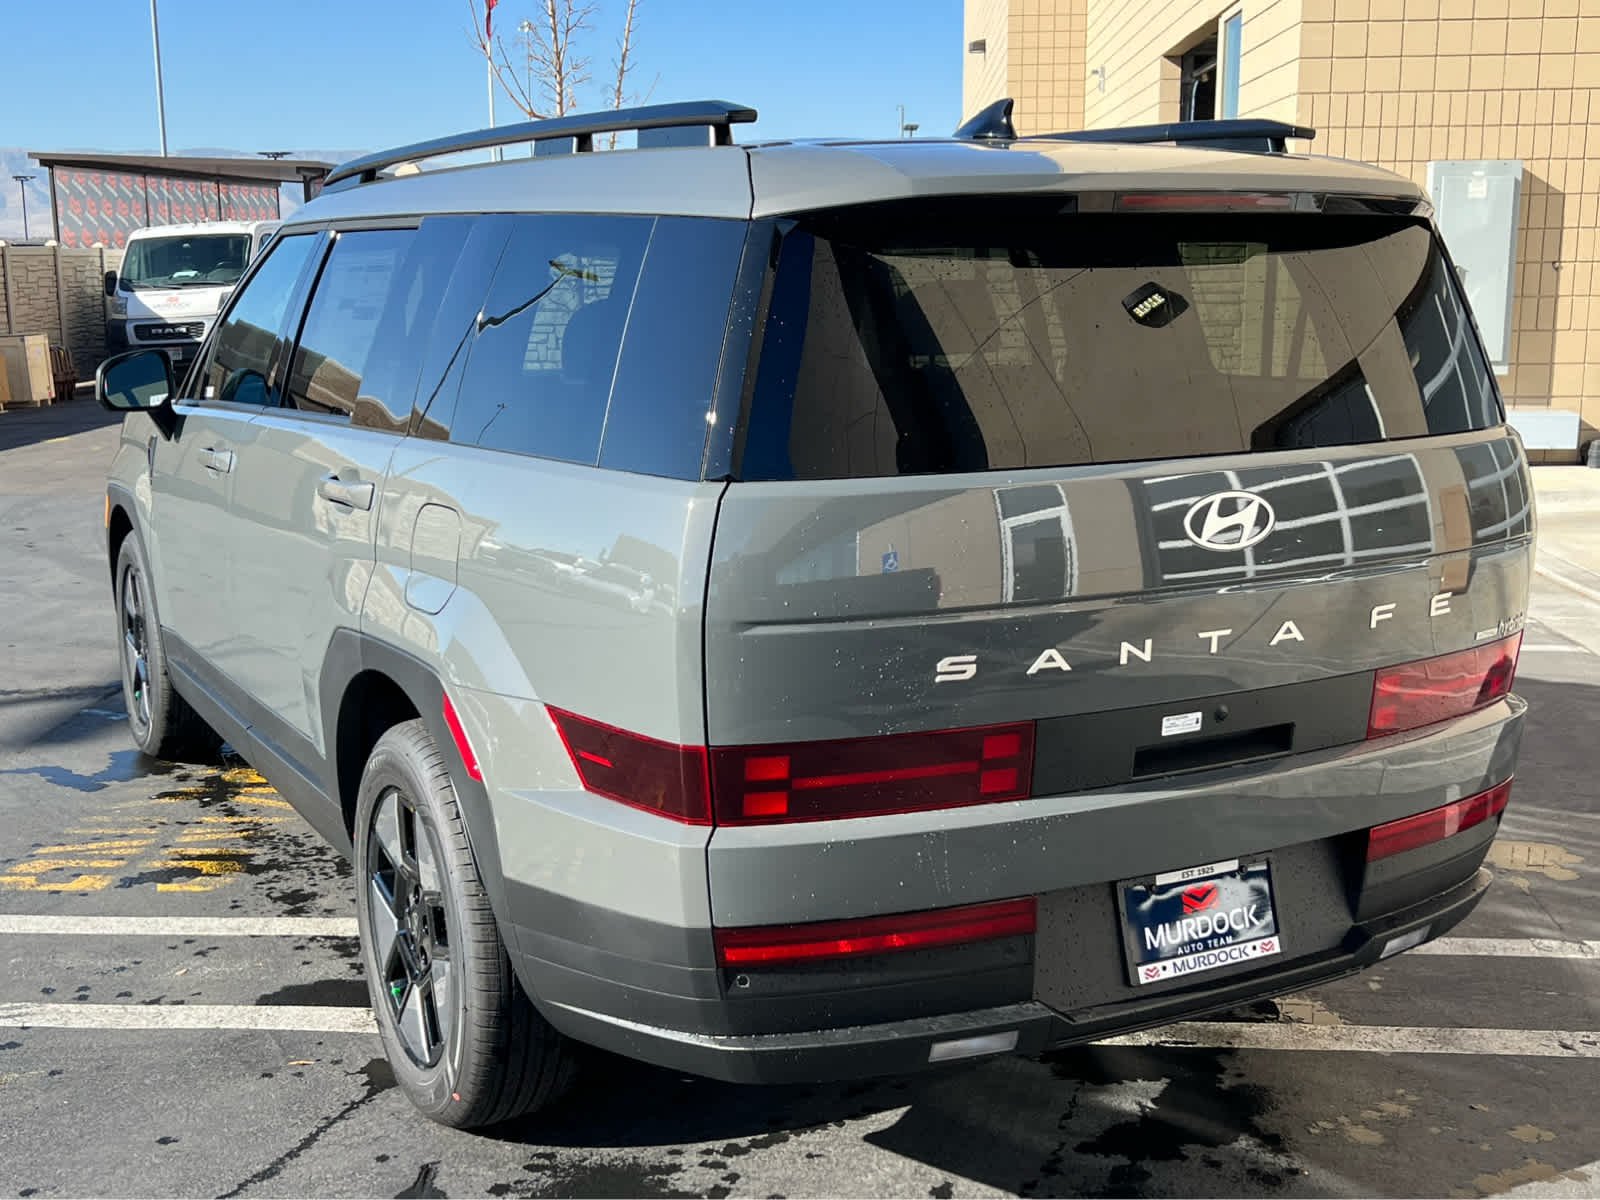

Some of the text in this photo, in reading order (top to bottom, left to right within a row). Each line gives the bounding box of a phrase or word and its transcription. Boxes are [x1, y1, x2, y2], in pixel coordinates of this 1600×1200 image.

[151, 327, 187, 335] RAM
[935, 591, 1453, 683] SANTA FE
[1144, 904, 1260, 950] MURDOCK
[1173, 945, 1249, 974] MURDOCK
[1177, 936, 1233, 955] AUTO TEAM
